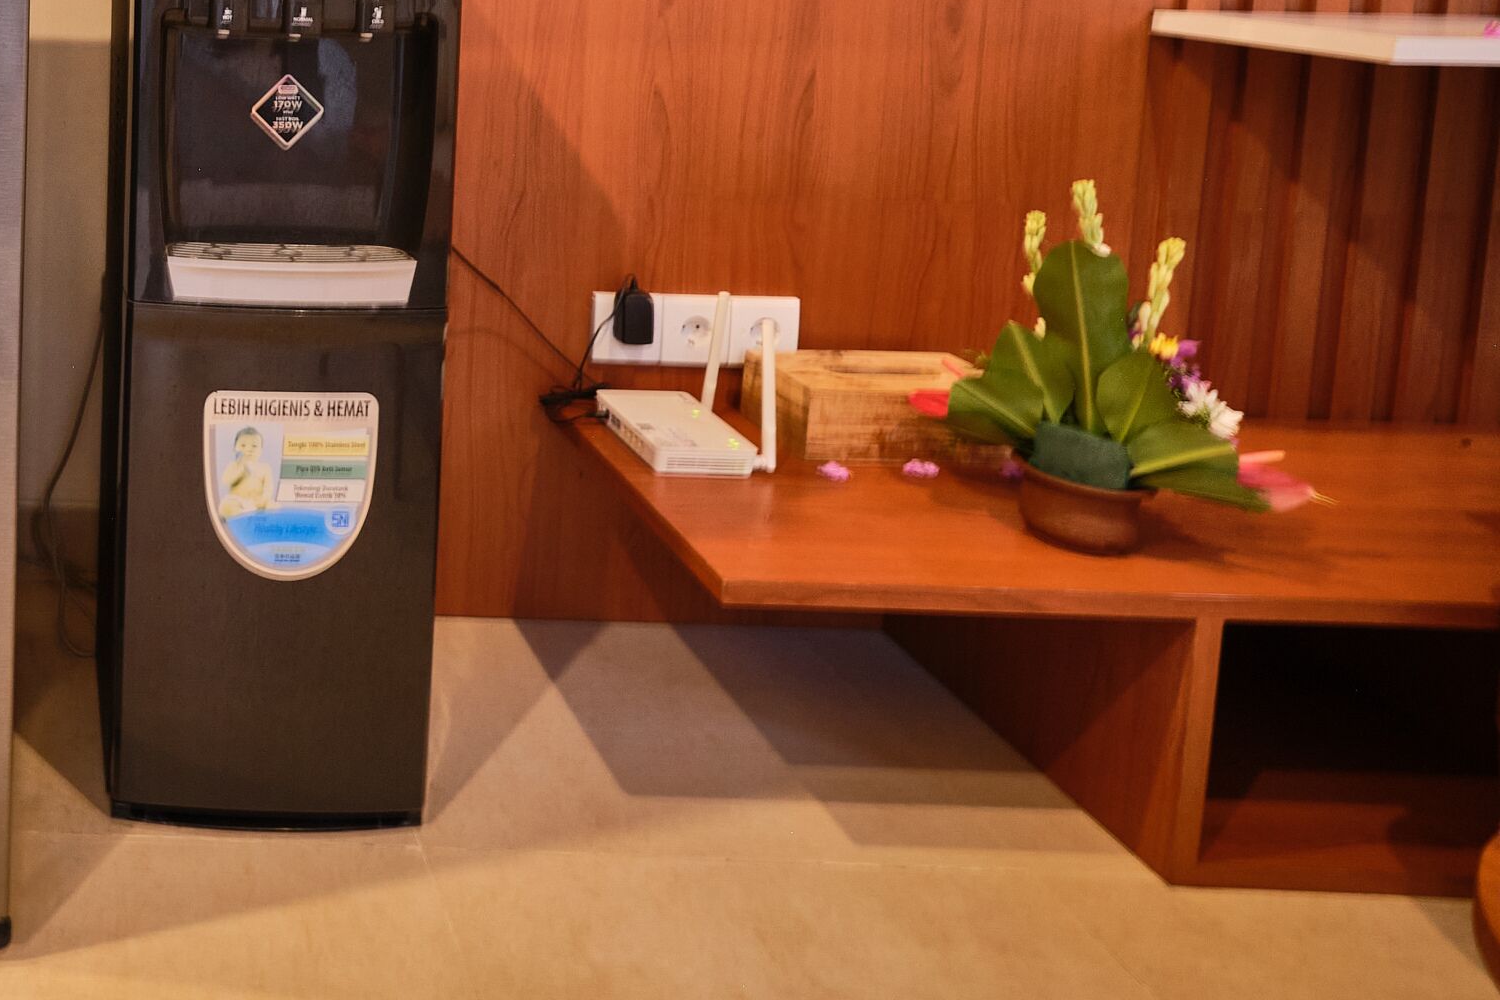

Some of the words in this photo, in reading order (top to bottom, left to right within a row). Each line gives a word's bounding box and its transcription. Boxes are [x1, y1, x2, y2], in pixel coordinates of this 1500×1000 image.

[274, 100, 303, 110] 170W
[273, 121, 304, 131] 350W
[213, 399, 250, 416] LEBIH
[255, 399, 311, 417] HIGIENIS
[314, 401, 323, 417] &
[327, 400, 371, 418] HEMAT
